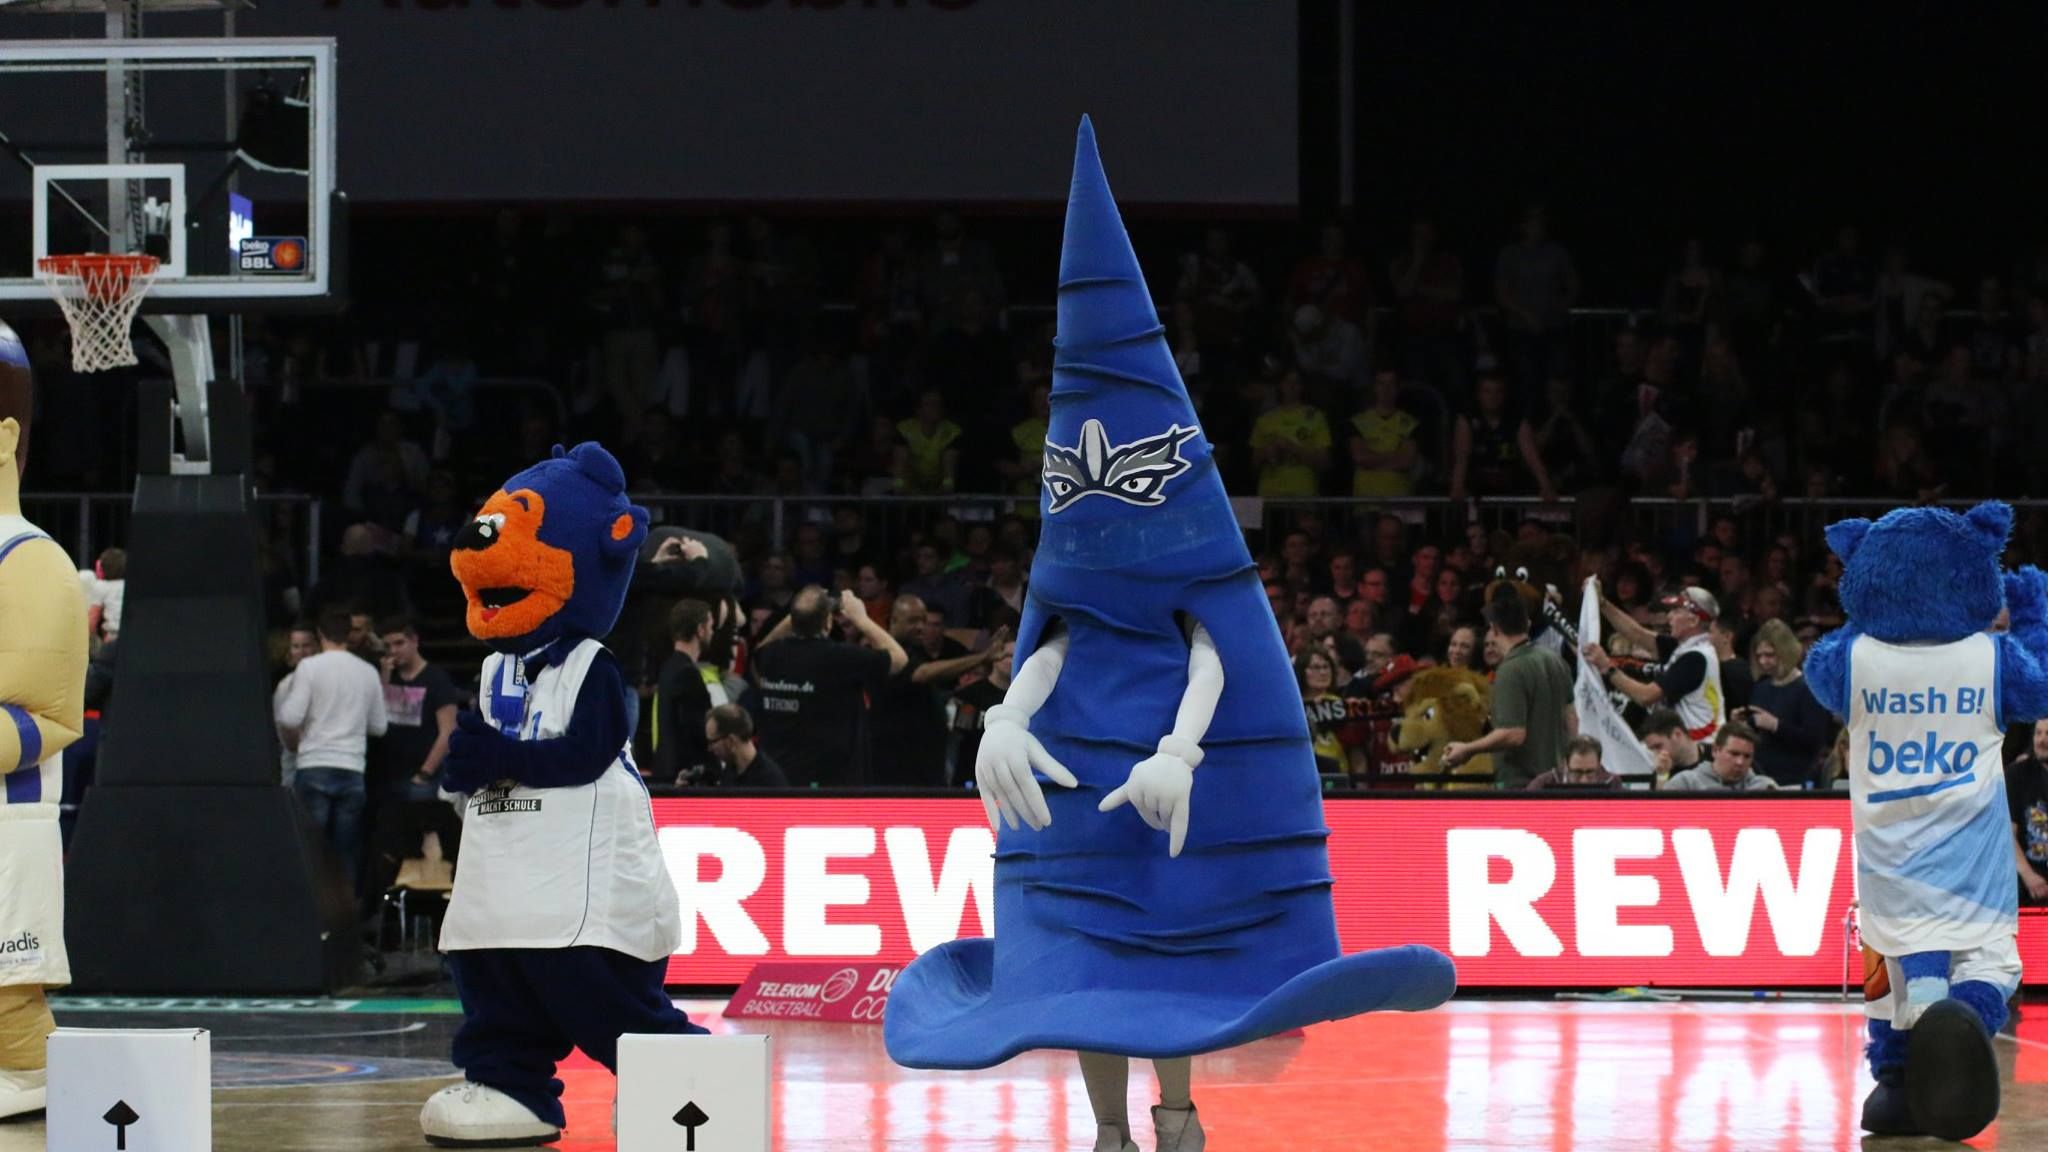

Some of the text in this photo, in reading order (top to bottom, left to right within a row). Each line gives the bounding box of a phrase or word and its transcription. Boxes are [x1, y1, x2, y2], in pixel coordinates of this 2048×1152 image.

[241, 257, 273, 269] BBL
[1862, 687, 1985, 715] Wash B!
[1867, 730, 1978, 775] beko
[480, 800, 537, 813] MACHT SCHULE
[1446, 826, 1858, 957] REW
[756, 982, 821, 999] TELEKOM
[742, 999, 825, 1017] BASKETBALL
[851, 995, 888, 1020] CO
